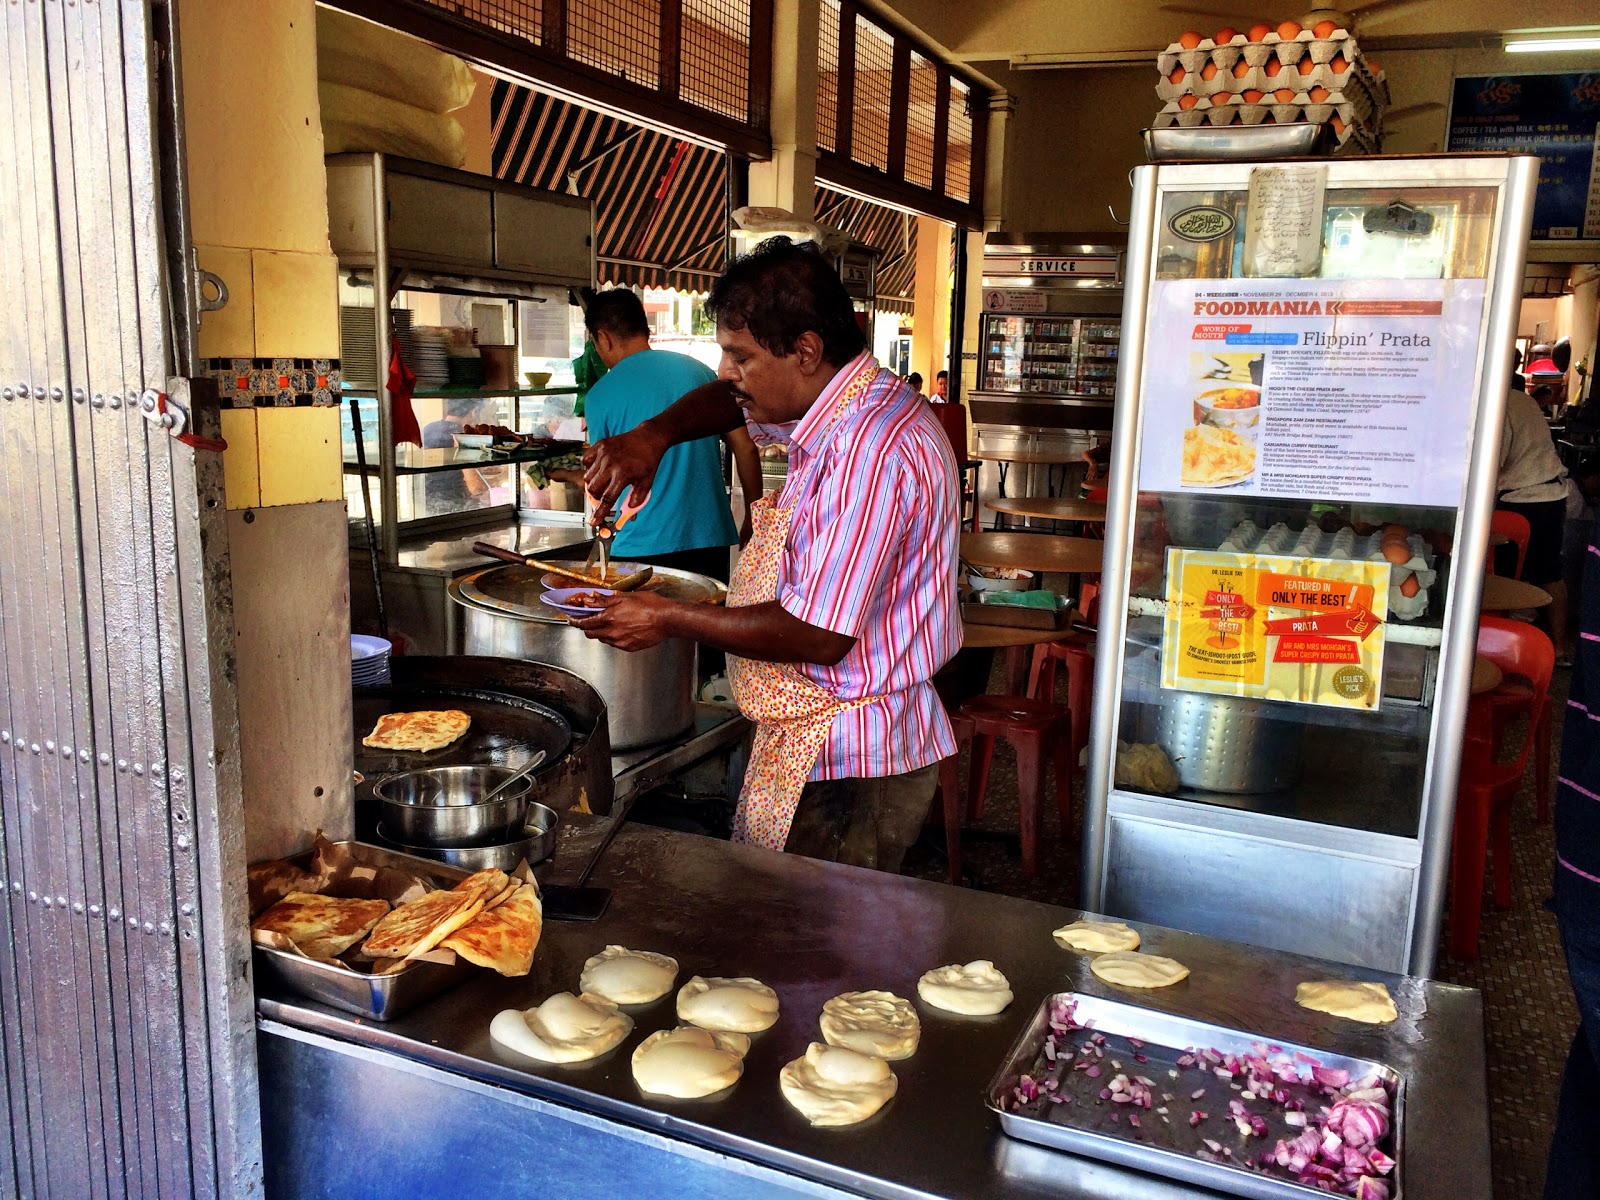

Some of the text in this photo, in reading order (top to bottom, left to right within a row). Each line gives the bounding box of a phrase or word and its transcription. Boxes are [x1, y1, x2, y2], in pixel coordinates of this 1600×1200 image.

[1452, 125, 1479, 134] COFFEE
[1485, 125, 1498, 133] TEA
[1500, 125, 1514, 133] with
[1515, 124, 1534, 133] MILK
[1451, 136, 1477, 144] COFFEE
[1484, 135, 1497, 144] TEA
[1515, 135, 1533, 143] MILK
[1020, 261, 1076, 272] SERVICE
[1194, 301, 1323, 316] FOODMANIA
[1380, 332, 1431, 347] Prata
[1284, 580, 1331, 592] FEATURED IN
[1216, 594, 1236, 603] ONLY
[1272, 591, 1297, 604] ONLY
[1300, 592, 1318, 605] THE
[1220, 608, 1234, 618] THE
[1218, 621, 1239, 632] BEST!
[1292, 621, 1318, 632] PRATA
[1188, 645, 1197, 653] THE
[1242, 651, 1257, 659] GUIDE
[1293, 642, 1305, 650] AND
[1320, 643, 1352, 652] MOHGAN'S
[1299, 651, 1320, 659] CRISPY
[1340, 675, 1364, 683] LESLIE'S
[1346, 684, 1360, 692] PICK
